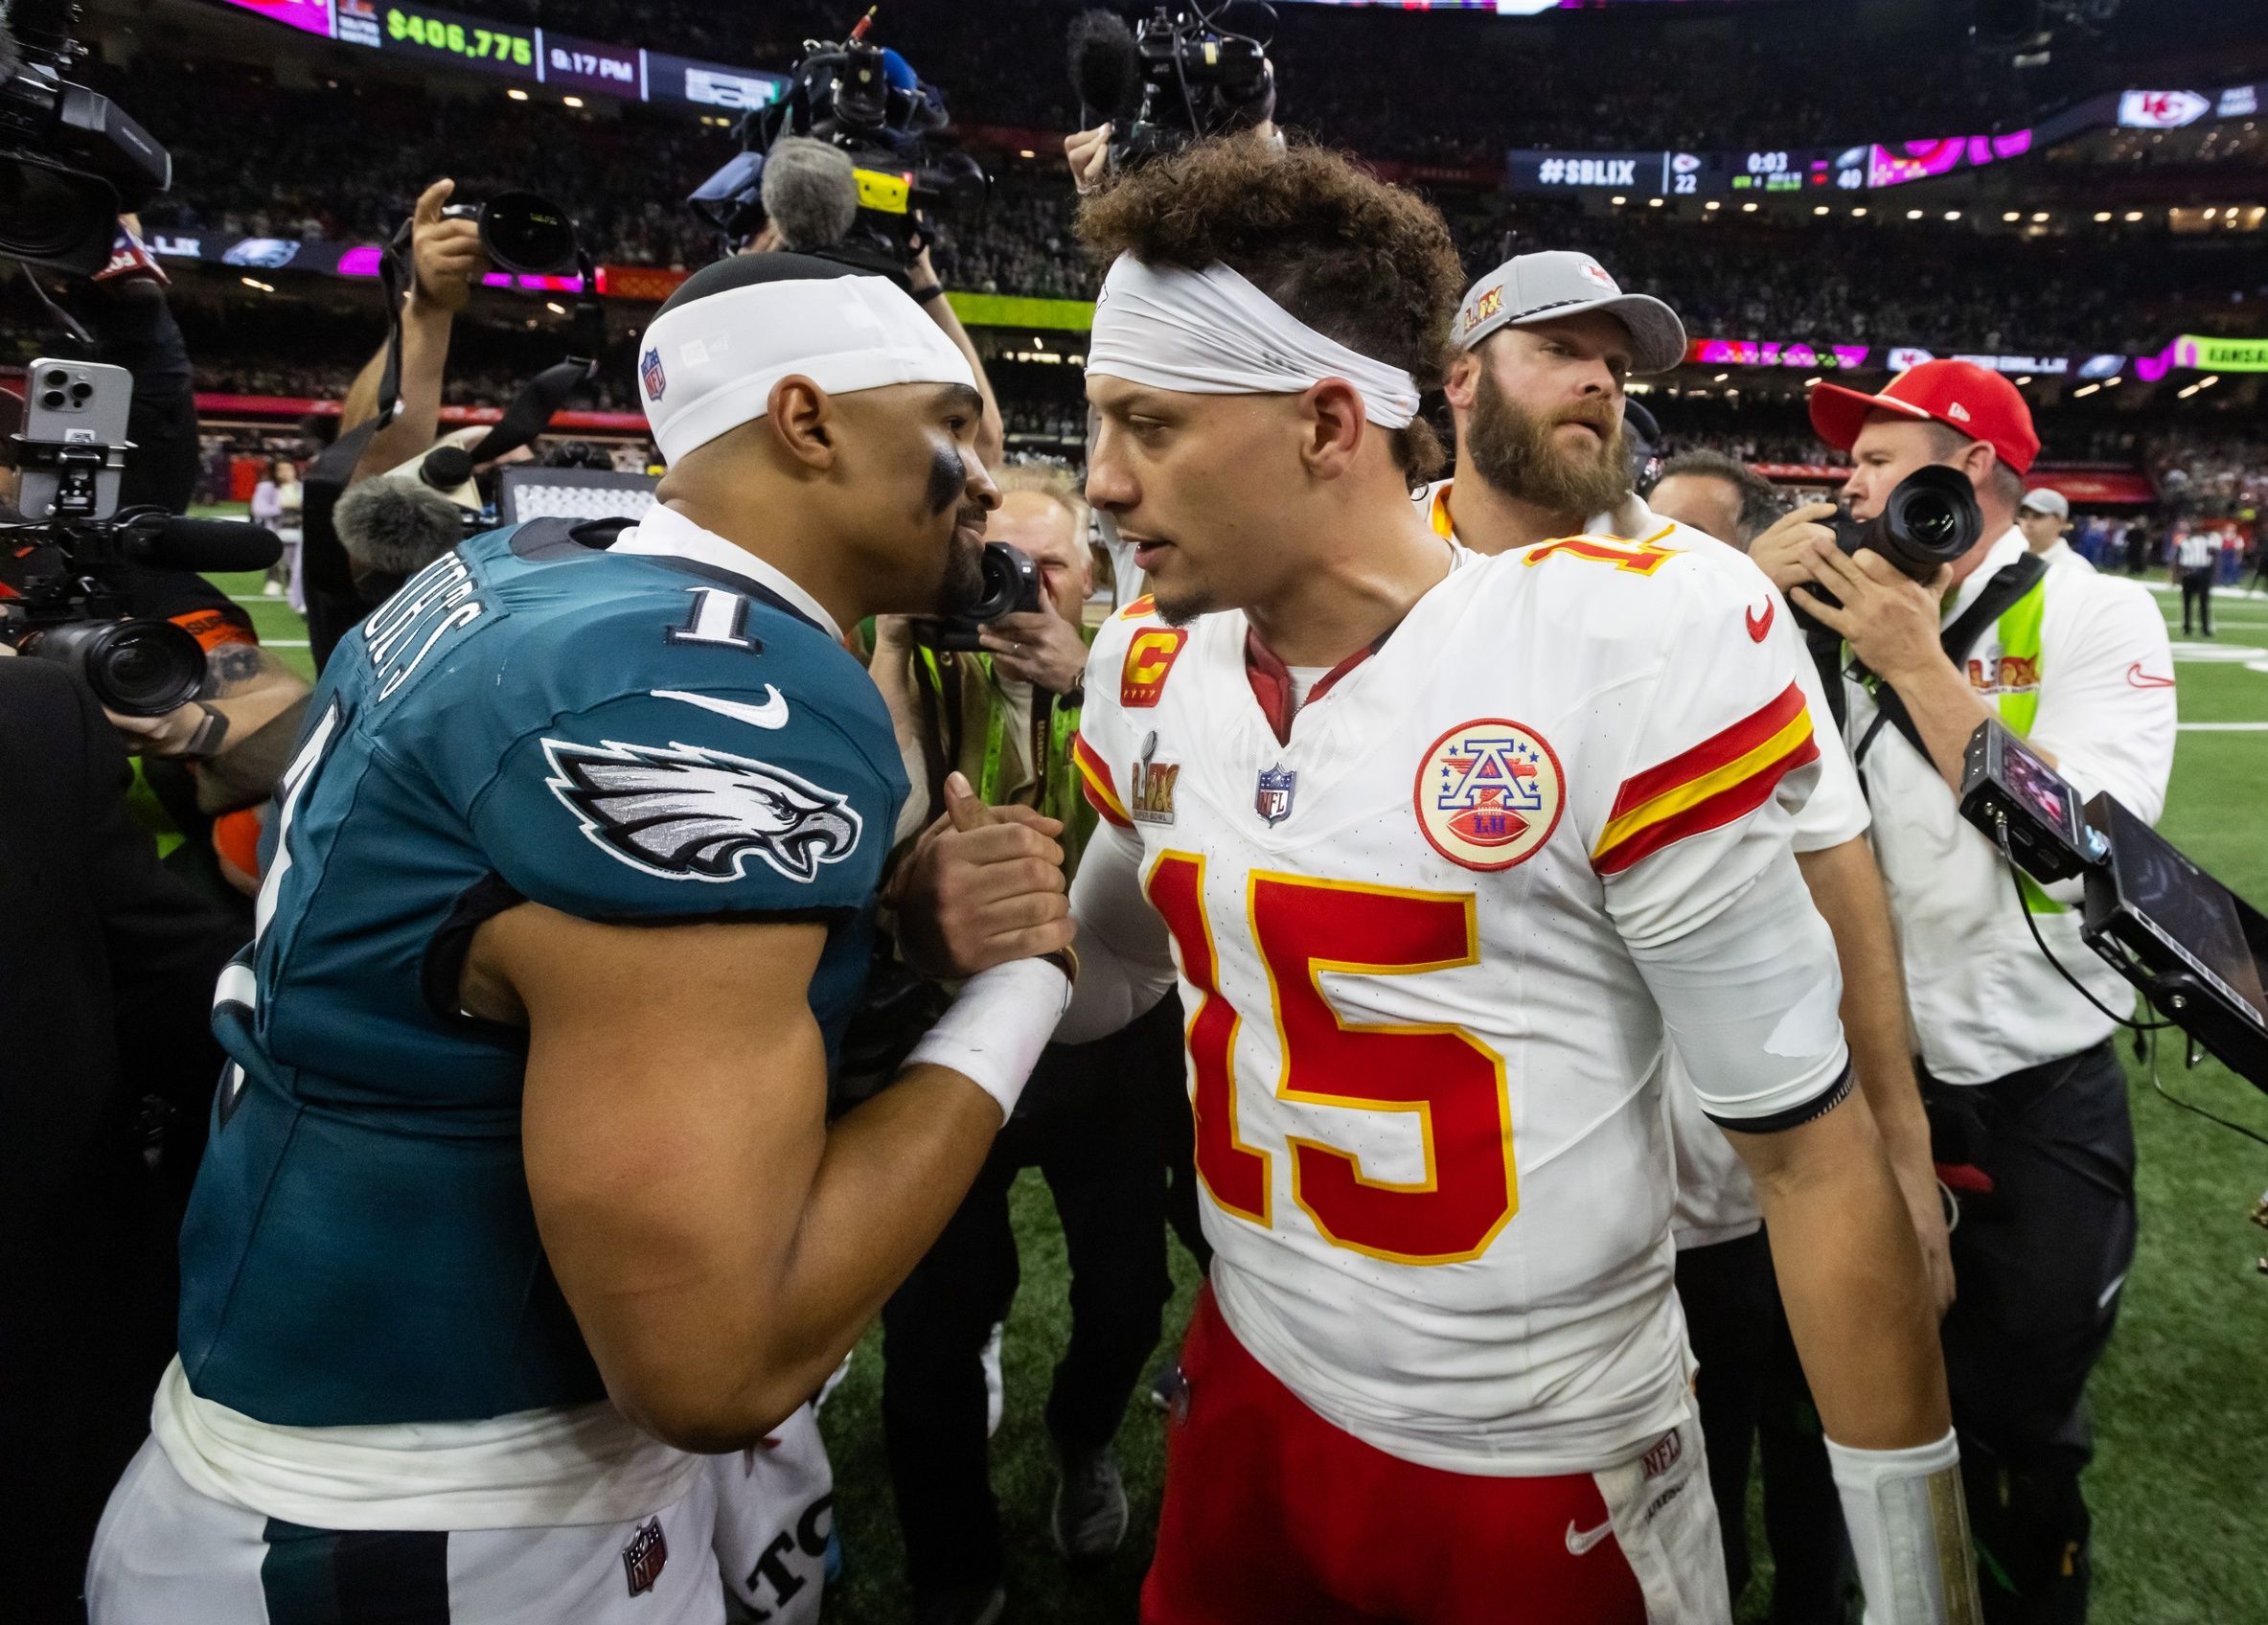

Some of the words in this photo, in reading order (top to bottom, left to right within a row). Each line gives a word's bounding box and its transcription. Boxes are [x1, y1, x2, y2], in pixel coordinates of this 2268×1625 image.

[387, 8, 533, 66] $406,775
[599, 57, 633, 83] PM
[1539, 157, 1636, 186] #SBLIX
[1747, 151, 1788, 173] 0:03
[1837, 169, 1863, 190] 40
[1674, 173, 1697, 194] 22
[664, 584, 763, 656] 1
[1125, 632, 1179, 684] C
[1968, 653, 2040, 688] LIX
[1036, 720, 1046, 776] Canon
[1438, 739, 1542, 811] A
[1257, 790, 1286, 816] NFL
[1149, 848, 1520, 1267] 15
[1642, 1436, 1680, 1477] NFL
